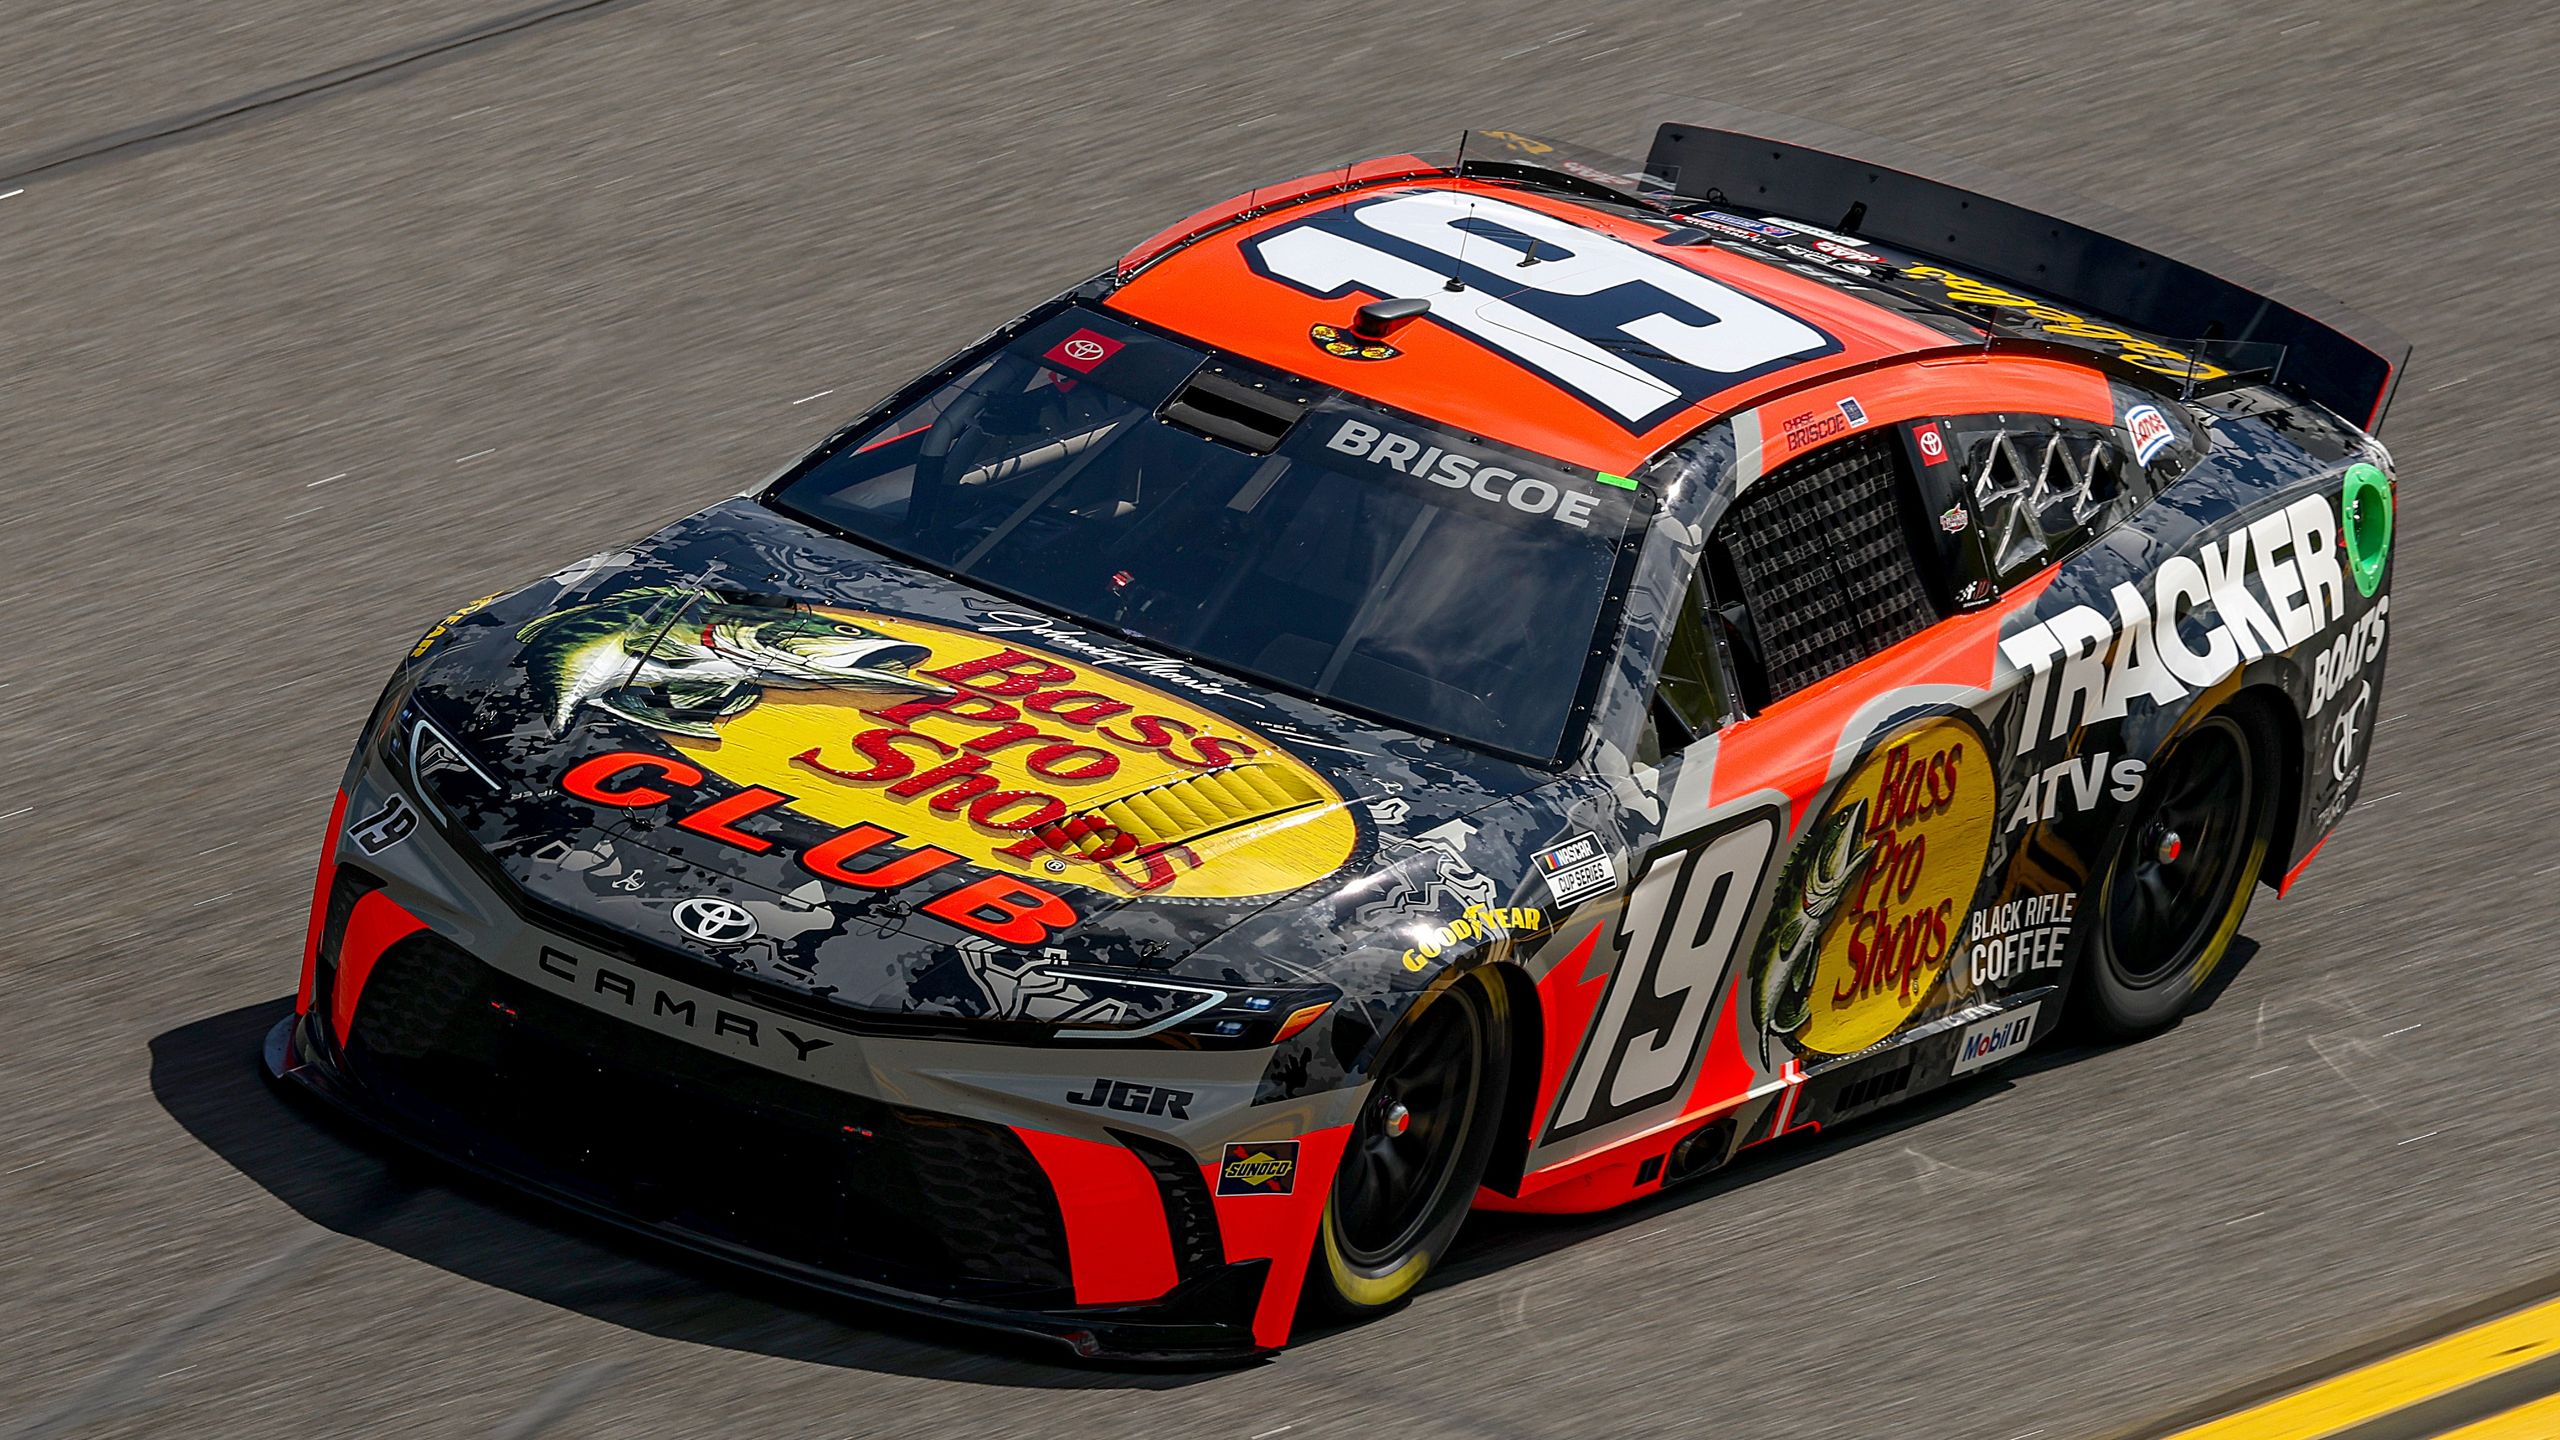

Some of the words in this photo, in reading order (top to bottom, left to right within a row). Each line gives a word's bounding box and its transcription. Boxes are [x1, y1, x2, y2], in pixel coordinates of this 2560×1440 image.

[1250, 189, 1834, 427] 19
[1901, 261, 2229, 380] Cabela's
[1783, 411, 1814, 432] CHASE
[1787, 414, 1845, 451] BRISCOE
[2129, 413, 2167, 448] Lance
[1326, 419, 1601, 528] BRISCOE
[978, 612, 1129, 665] Johnny
[1104, 648, 1266, 709] Morris
[1999, 493, 2345, 756] TRACKER
[2306, 595, 2390, 719] BOATS
[861, 690, 1121, 780] Pro
[916, 647, 1257, 768] Bass
[346, 792, 419, 856] 19
[790, 728, 1202, 896] Shops
[1866, 743, 1963, 833] Bass
[2005, 752, 2147, 832] ATVs
[561, 751, 1079, 946] CLUB
[1556, 839, 1594, 867] NASCAR
[1558, 874, 1575, 893] CUP
[1575, 862, 1605, 887] SERIES
[1853, 831, 1926, 915] Pro
[1402, 904, 1541, 972] GOODYEAR
[1832, 898, 1952, 1009] Shops
[1971, 901, 2021, 942] BLACK
[2025, 892, 2077, 925] RIFLE
[1971, 927, 2071, 987] COFFEE
[538, 945, 834, 1062] CAMRY
[1546, 808, 1778, 1140] 19
[1962, 1024, 2013, 1062] Mobil
[2014, 1018, 2028, 1045] 1
[1066, 1078, 1194, 1121] JGR
[1226, 1161, 1291, 1177] SUNOCO
